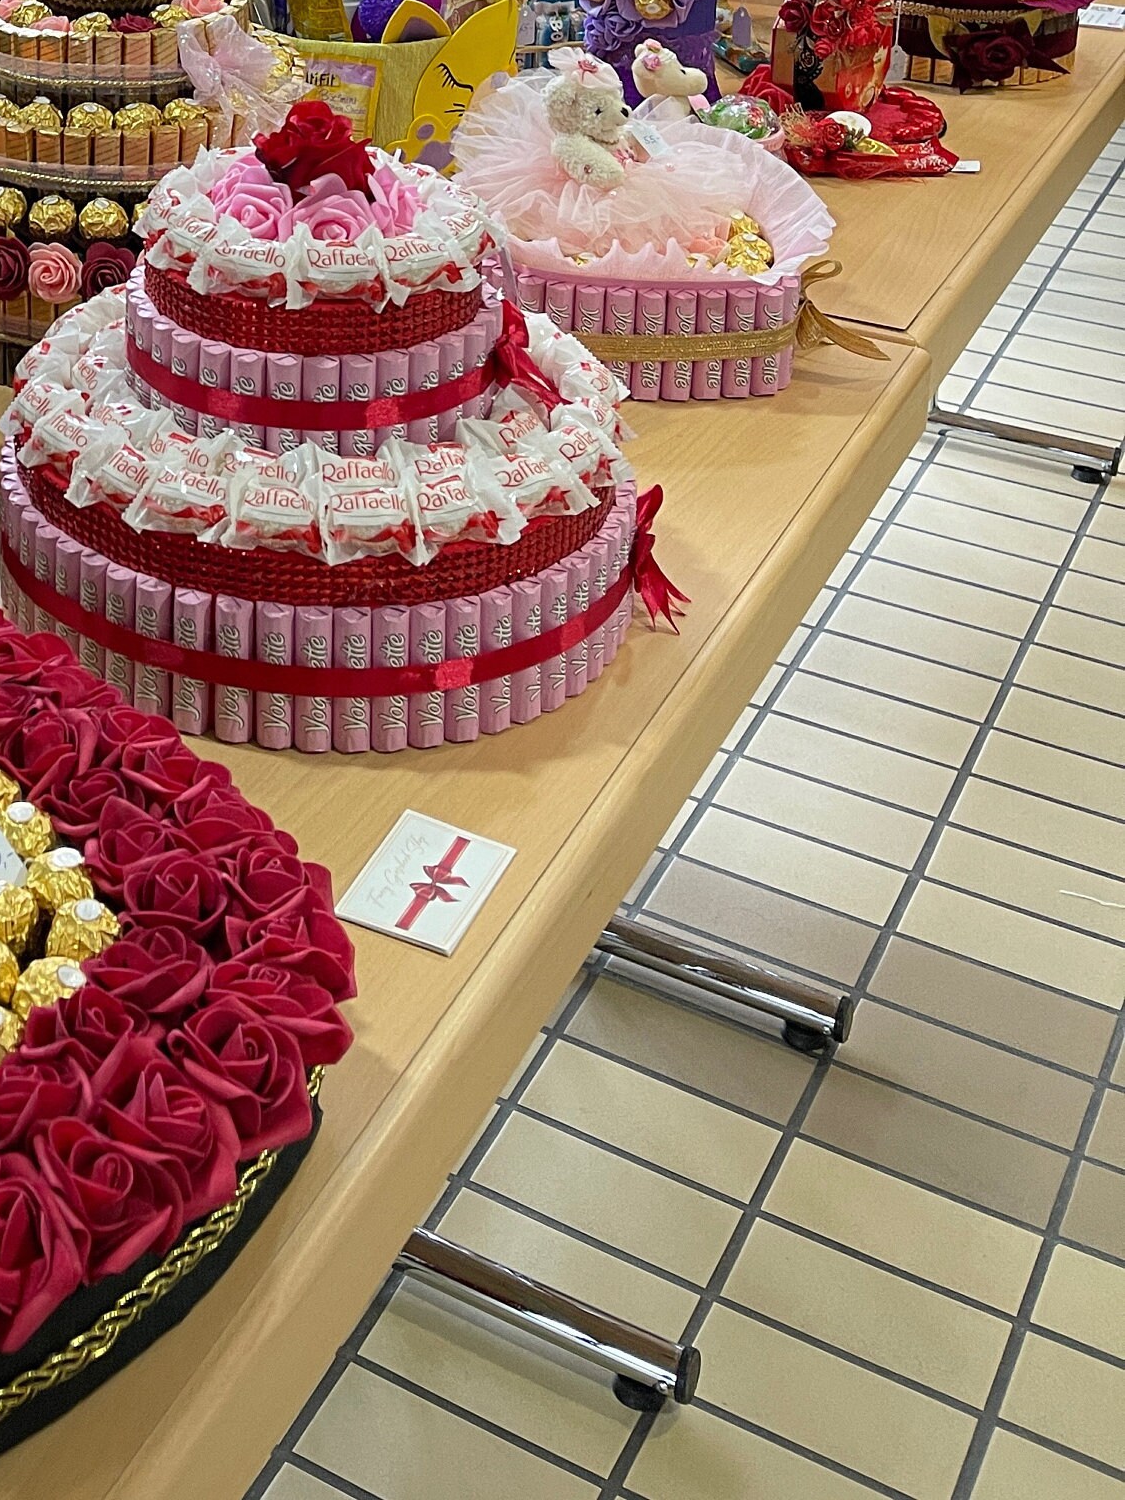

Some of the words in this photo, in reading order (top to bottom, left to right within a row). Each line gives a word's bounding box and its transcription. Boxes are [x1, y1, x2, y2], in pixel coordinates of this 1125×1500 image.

[305, 71, 336, 87] ltiFit
[323, 461, 395, 483] Raffaello
[495, 456, 551, 488] Raffae
